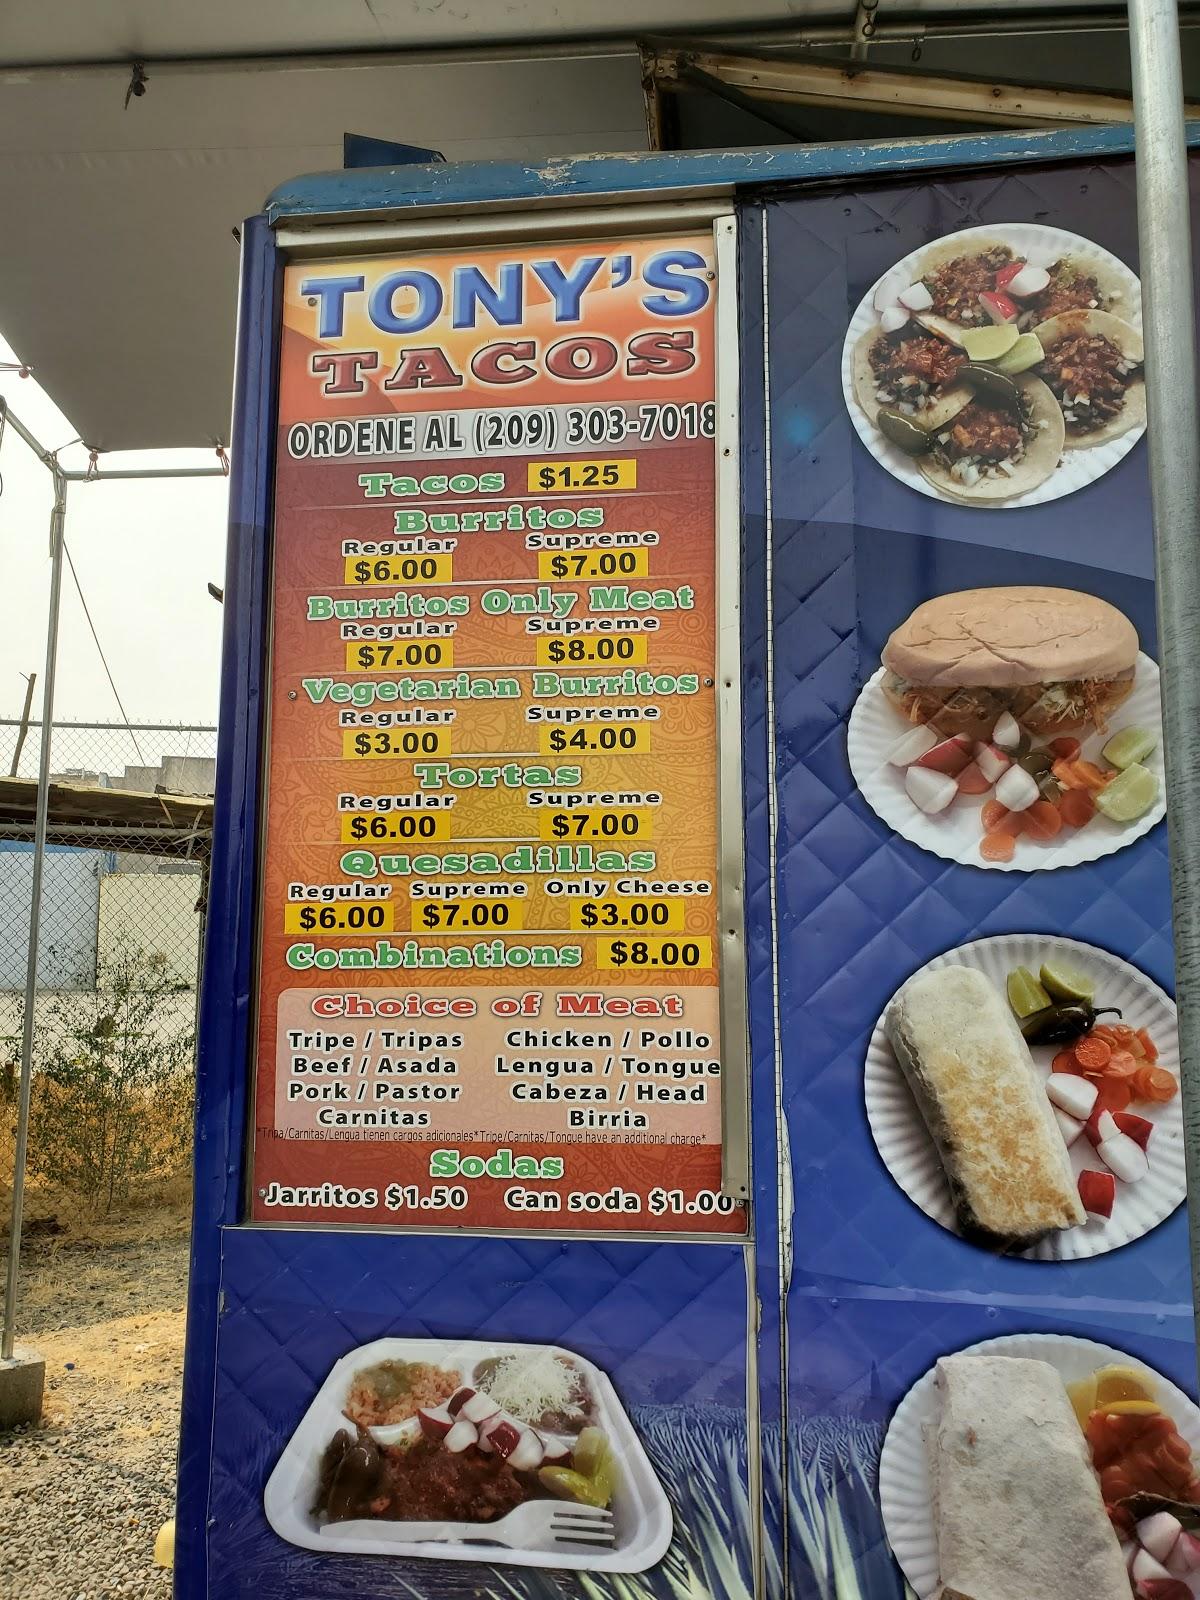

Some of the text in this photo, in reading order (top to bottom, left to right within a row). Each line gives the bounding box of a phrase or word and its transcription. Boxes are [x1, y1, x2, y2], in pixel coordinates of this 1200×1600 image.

[312, 331, 696, 395] TACOS
[290, 404, 716, 456] ORDENE AL (209) 303-7018
[360, 464, 619, 496] Tacos $1.25
[395, 506, 603, 533] Burritos
[344, 536, 455, 556] Regular
[527, 531, 658, 549] Supreme
[354, 558, 438, 583] $6.00
[551, 552, 637, 578] $7.00
[308, 586, 694, 620] Burritos Only Meat
[343, 621, 456, 640] Regular
[527, 617, 659, 634] Supreme
[357, 643, 442, 669] $7.00
[548, 637, 635, 663] $8.00
[303, 672, 699, 703] Vegetarian Burritos
[341, 708, 455, 728] Regular
[527, 706, 659, 723] Supreme
[354, 731, 439, 755] $3.00
[549, 726, 637, 753] $4.00
[414, 763, 582, 788] Tortas
[340, 793, 455, 811] Regular
[528, 791, 661, 808] Supreme
[350, 815, 437, 840] $6.00
[551, 813, 640, 838] $7.00
[340, 845, 656, 877] Quesadillas
[290, 882, 391, 901] Regular
[411, 882, 527, 899] Supreme
[545, 880, 710, 898] Only Cheese
[299, 906, 386, 931] $6.00
[422, 904, 509, 929] $7.00
[581, 903, 669, 929] $3.00
[286, 941, 700, 971] Combinations $8.00
[312, 993, 683, 1018] Choice of Meat
[289, 1032, 356, 1050] Tripe
[381, 1032, 463, 1051] Tripas
[507, 1030, 613, 1048] Chicken
[641, 1031, 710, 1049] Pollo
[294, 1057, 351, 1075] Beef
[377, 1057, 457, 1074] Asada
[497, 1057, 594, 1079] Lengua
[622, 1058, 720, 1079] Tongue
[289, 1083, 349, 1101] Pork
[375, 1083, 462, 1101] Pastor
[511, 1084, 608, 1101] Cabeza
[637, 1085, 705, 1102] Head
[319, 1109, 430, 1126] Carnitas
[570, 1111, 646, 1128] Birria
[363, 1129, 390, 1141] tienen
[394, 1130, 423, 1143] cargos
[585, 1131, 607, 1142] have
[610, 1133, 622, 1143] an
[624, 1131, 667, 1144] additional
[430, 1150, 564, 1179] Sodas
[267, 1185, 466, 1208] Jarritos $1.50
[506, 1189, 733, 1213] Can soda $1.00
